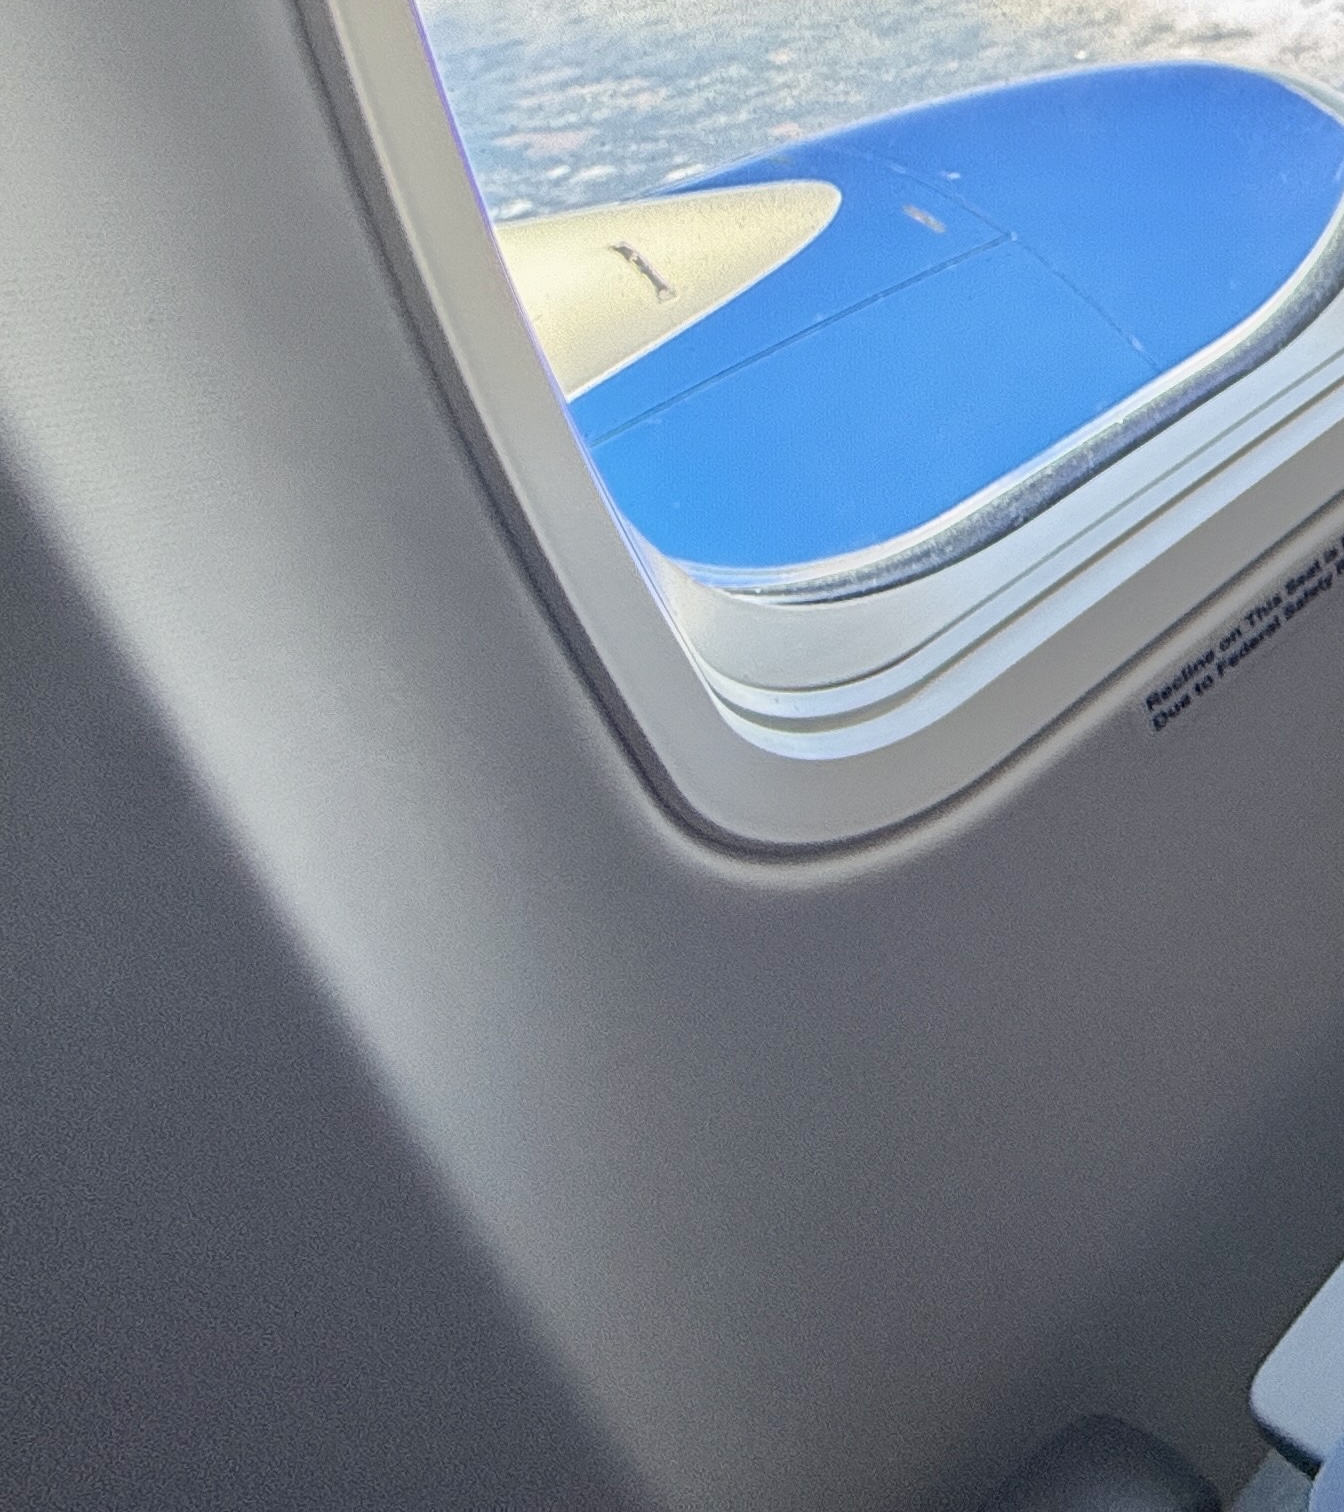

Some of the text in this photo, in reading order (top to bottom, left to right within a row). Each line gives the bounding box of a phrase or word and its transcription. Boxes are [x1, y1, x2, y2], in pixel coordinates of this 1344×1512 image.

[1147, 649, 1215, 713] Recline
[1220, 627, 1241, 651] on
[1245, 595, 1282, 626] This
[1285, 560, 1321, 595] Seat
[1153, 695, 1191, 731] Due
[1195, 675, 1214, 695] to
[1217, 616, 1281, 677] Federal
[1284, 573, 1333, 620] Safety
